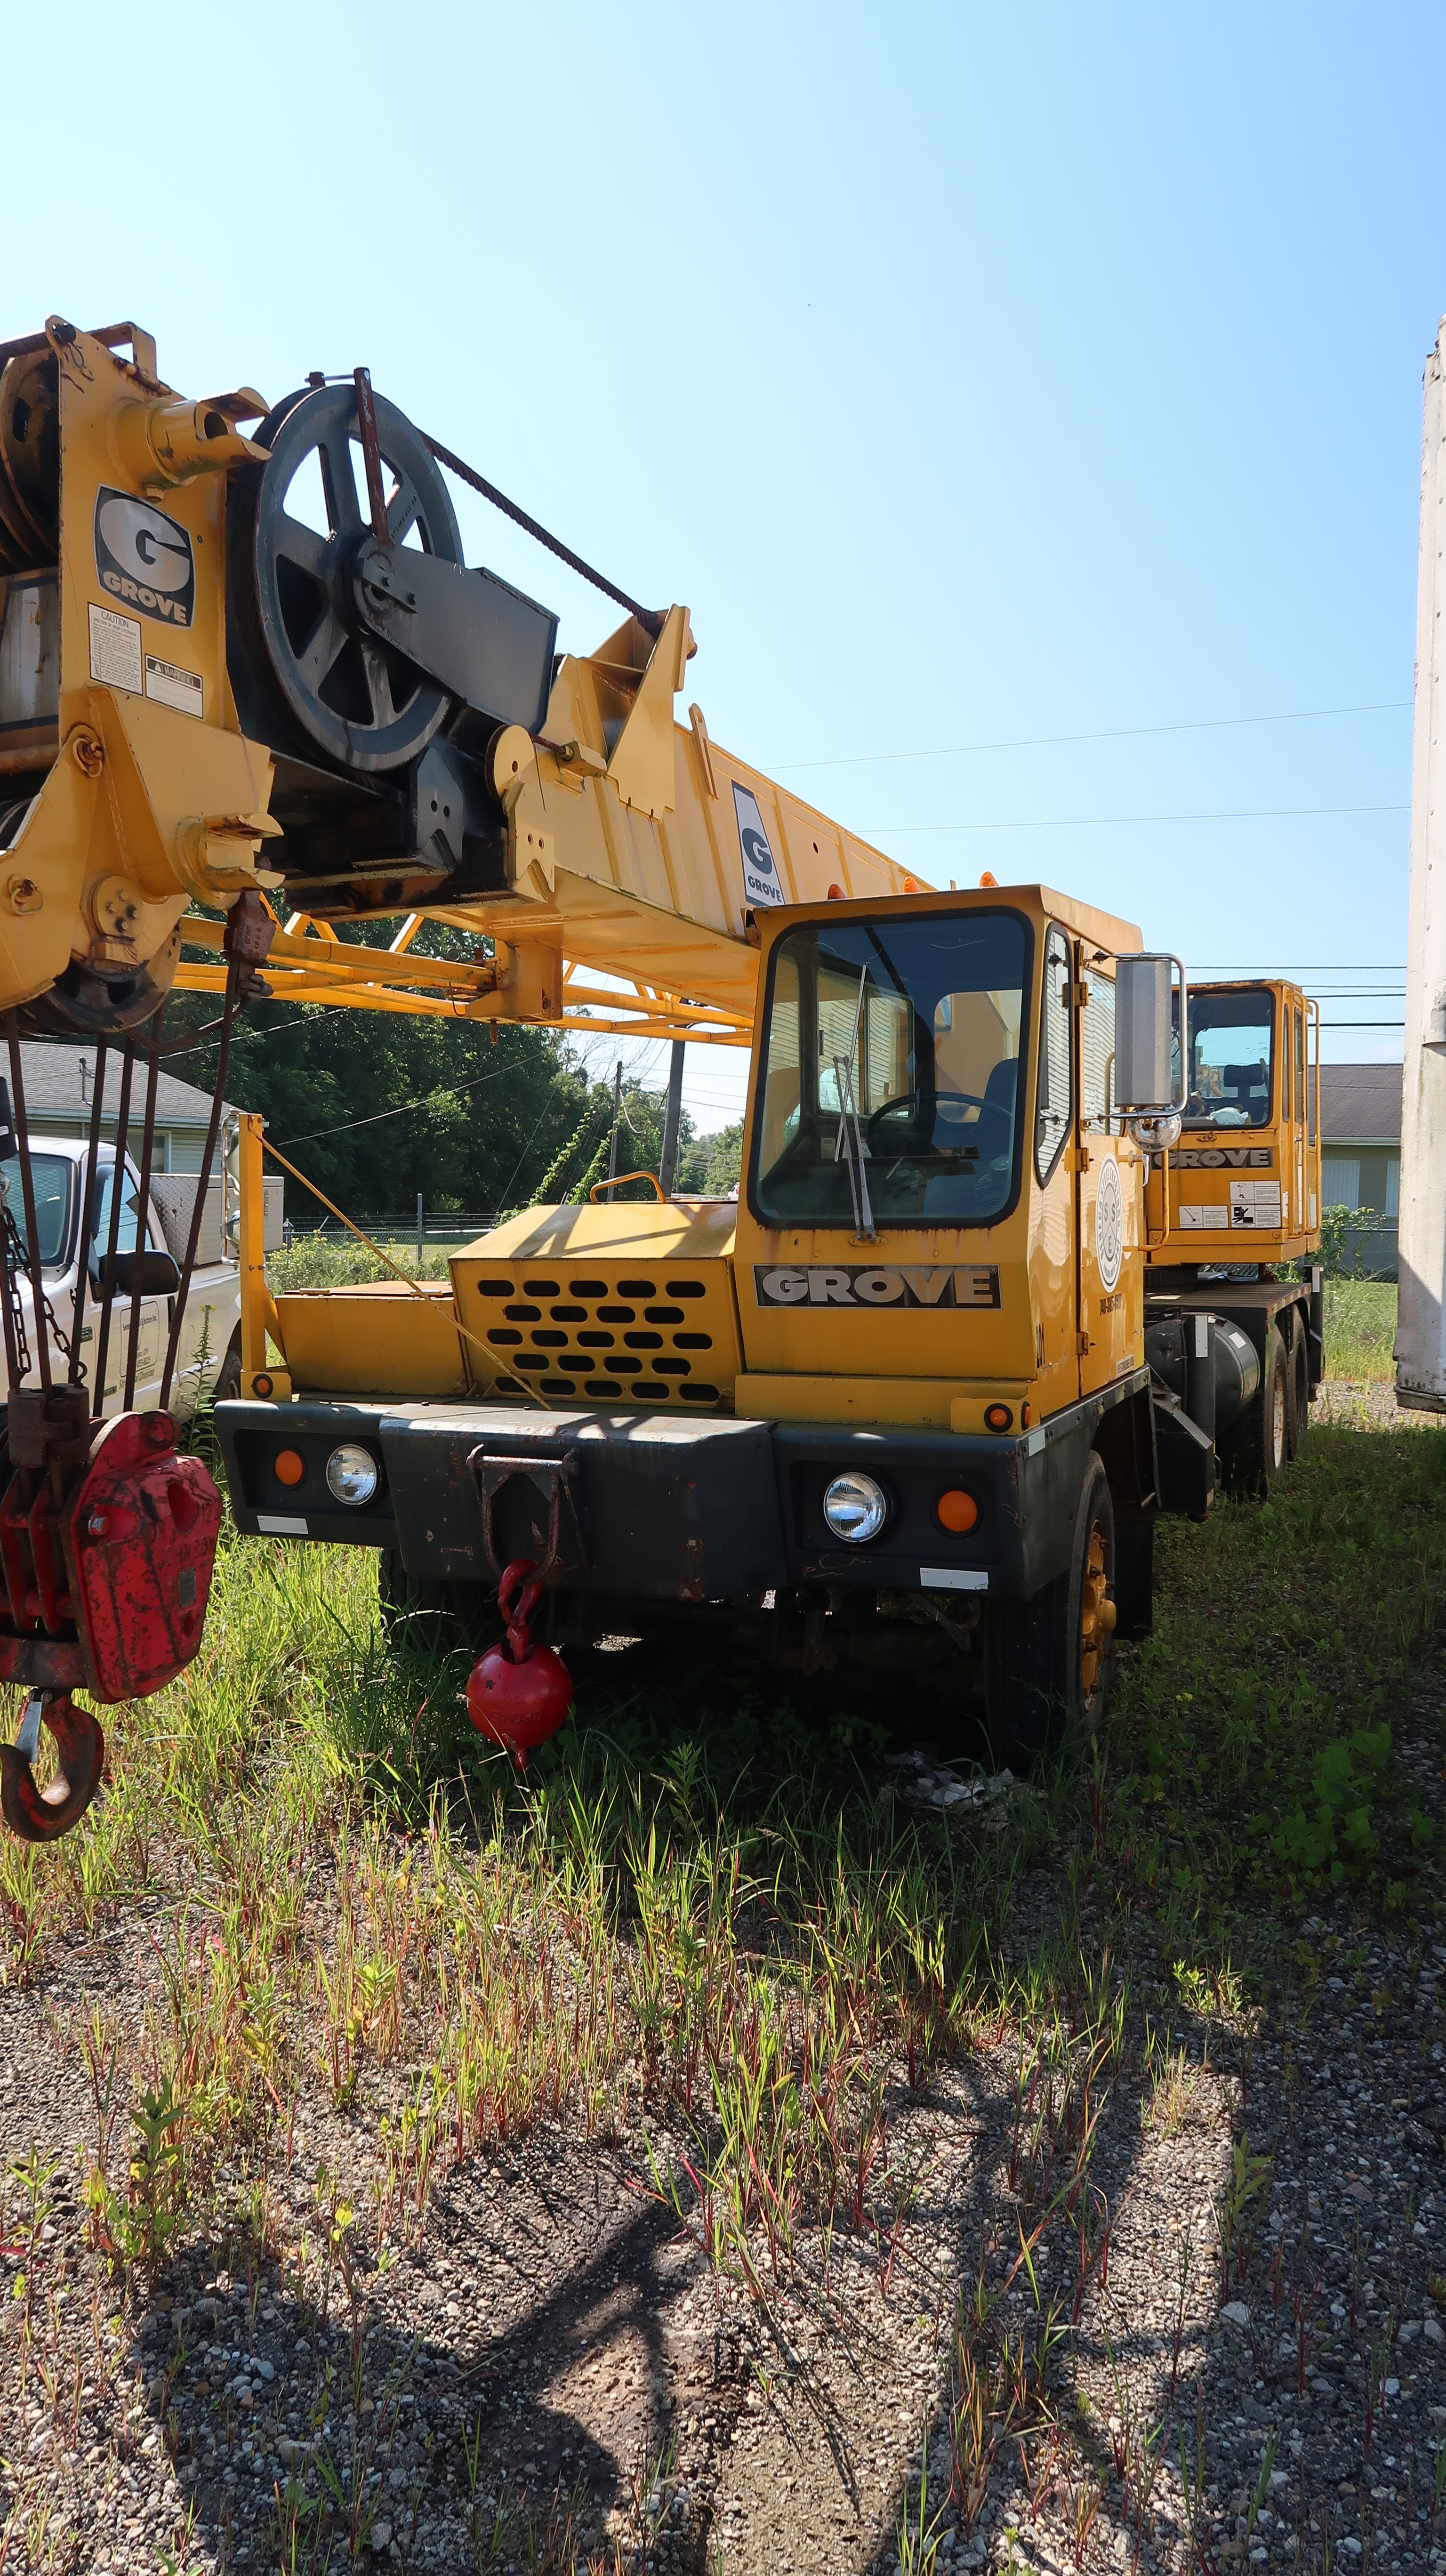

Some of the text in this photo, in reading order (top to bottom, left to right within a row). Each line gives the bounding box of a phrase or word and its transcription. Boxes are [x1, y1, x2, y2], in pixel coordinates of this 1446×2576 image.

[100, 499, 190, 592] G
[103, 571, 187, 625] GROVE
[101, 611, 129, 628] CAUTION
[164, 666, 194, 685] WARNING
[742, 827, 772, 874] G
[747, 875, 782, 903] GROVE
[1154, 1149, 1269, 1167] GROVE
[1104, 1201, 1115, 1223] S S
[1108, 1235, 1112, 1254] E
[762, 1270, 993, 1304] GROVE
[139, 1368, 155, 1381] Division
